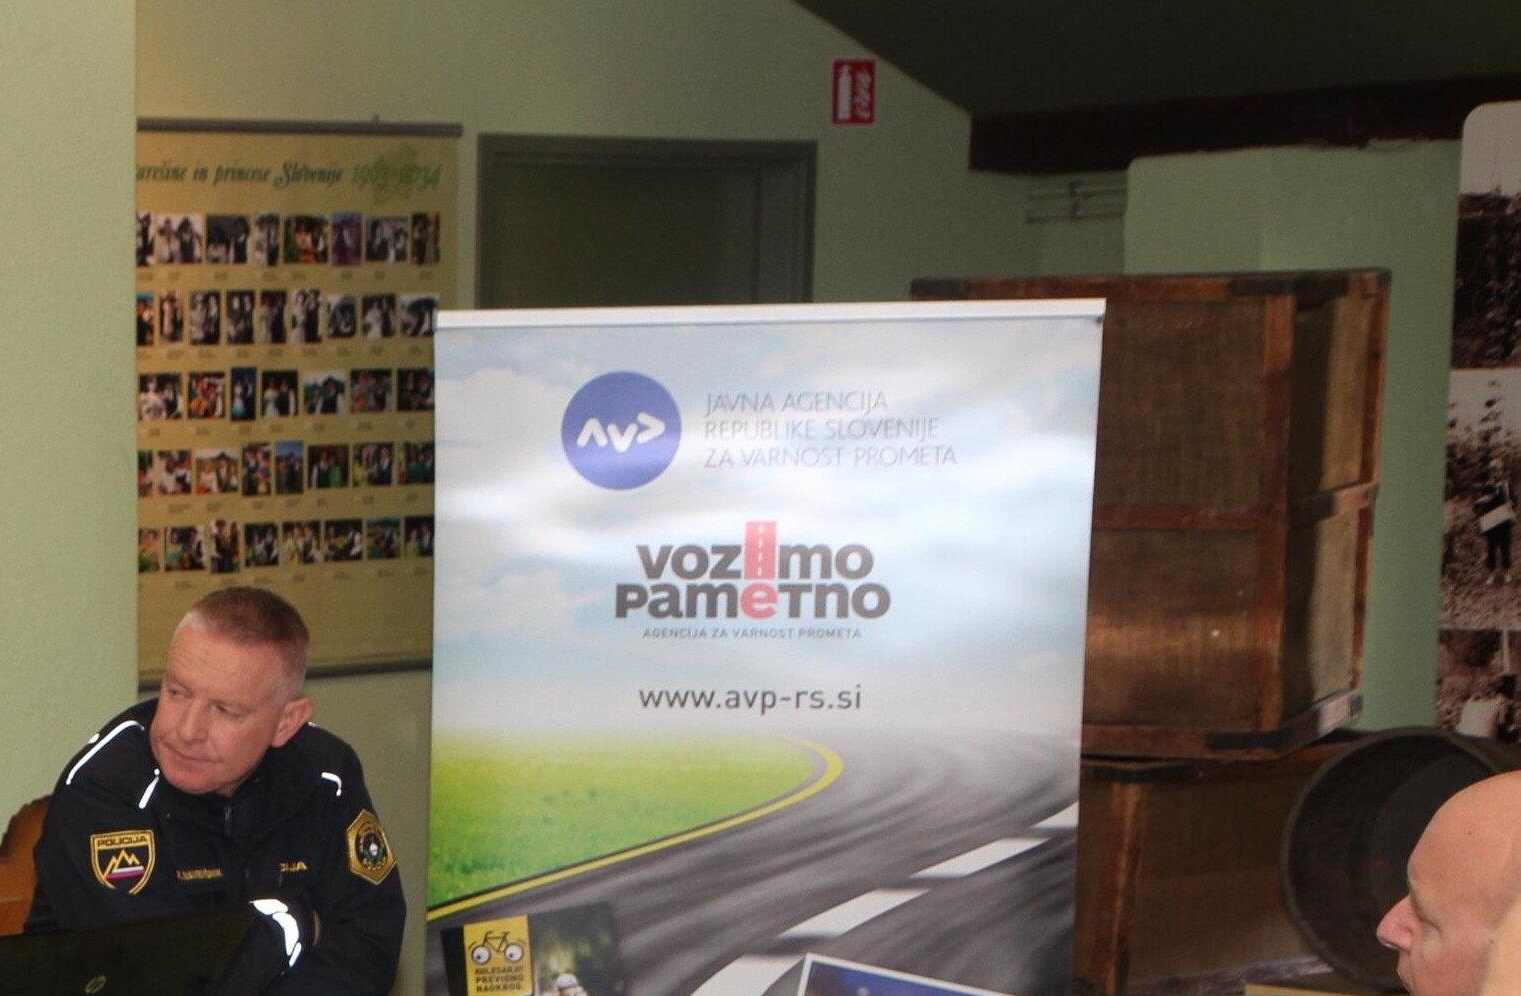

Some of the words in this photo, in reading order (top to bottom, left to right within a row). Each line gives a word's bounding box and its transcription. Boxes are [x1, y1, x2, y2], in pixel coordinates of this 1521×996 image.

[703, 392, 776, 418] JAVNA
[782, 390, 888, 417] AGENCIJA
[704, 419, 816, 440] REPUBLIKE
[825, 416, 939, 443] SLOVENIJE
[704, 447, 734, 468] ZA
[740, 446, 845, 468] VARNOST
[855, 444, 958, 467] PROMETA
[643, 627, 707, 639] AGENCIJA
[711, 628, 728, 639] ZA
[732, 627, 794, 639] VARNOST
[798, 627, 861, 639] PROMETA
[639, 684, 861, 715] www.avp-rs.si
[97, 835, 147, 847] POLICIJA
